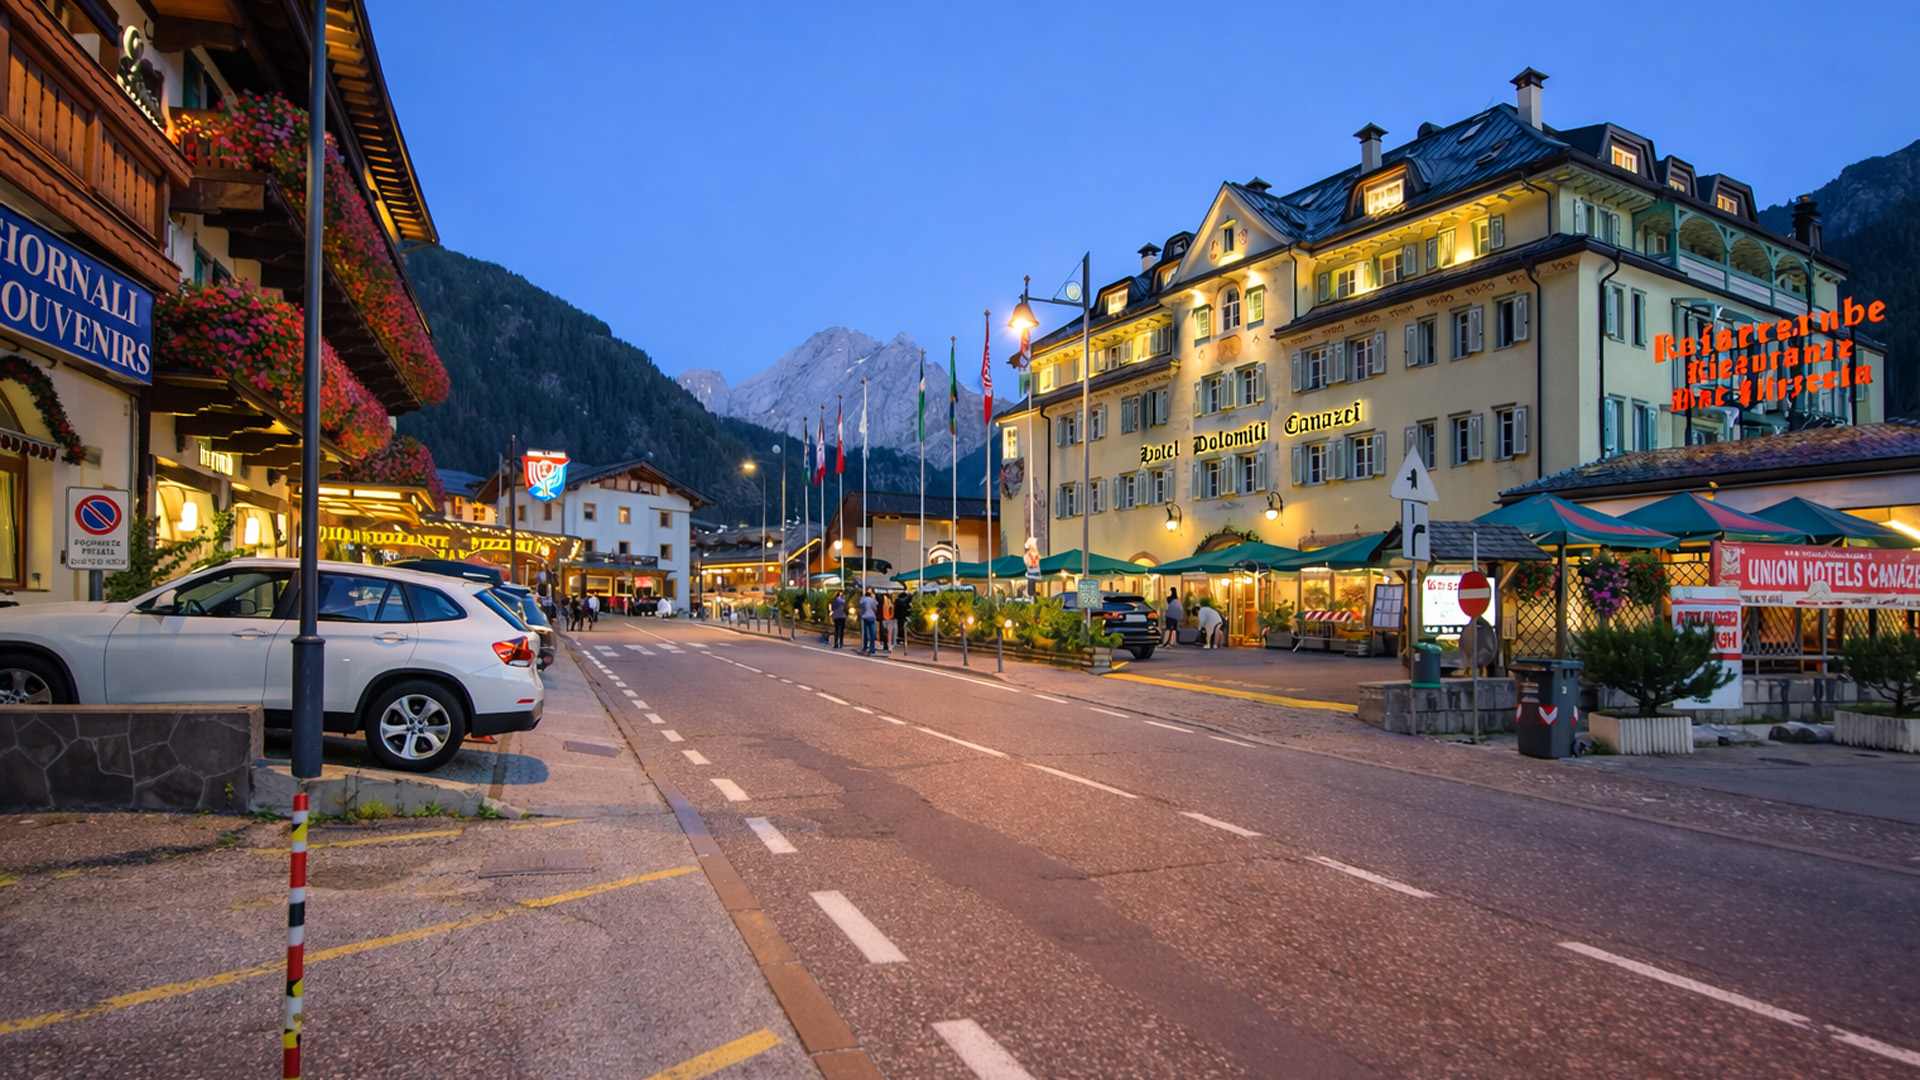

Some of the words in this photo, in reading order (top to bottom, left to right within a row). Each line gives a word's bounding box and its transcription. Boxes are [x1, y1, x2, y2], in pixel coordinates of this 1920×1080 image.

[0, 275, 150, 375] OUVENIRS
[1193, 422, 1267, 455] Dolomiti
[1284, 401, 1362, 434] Canazei
[1748, 559, 1799, 586] UNION
[1803, 561, 1863, 587] HOTELS
